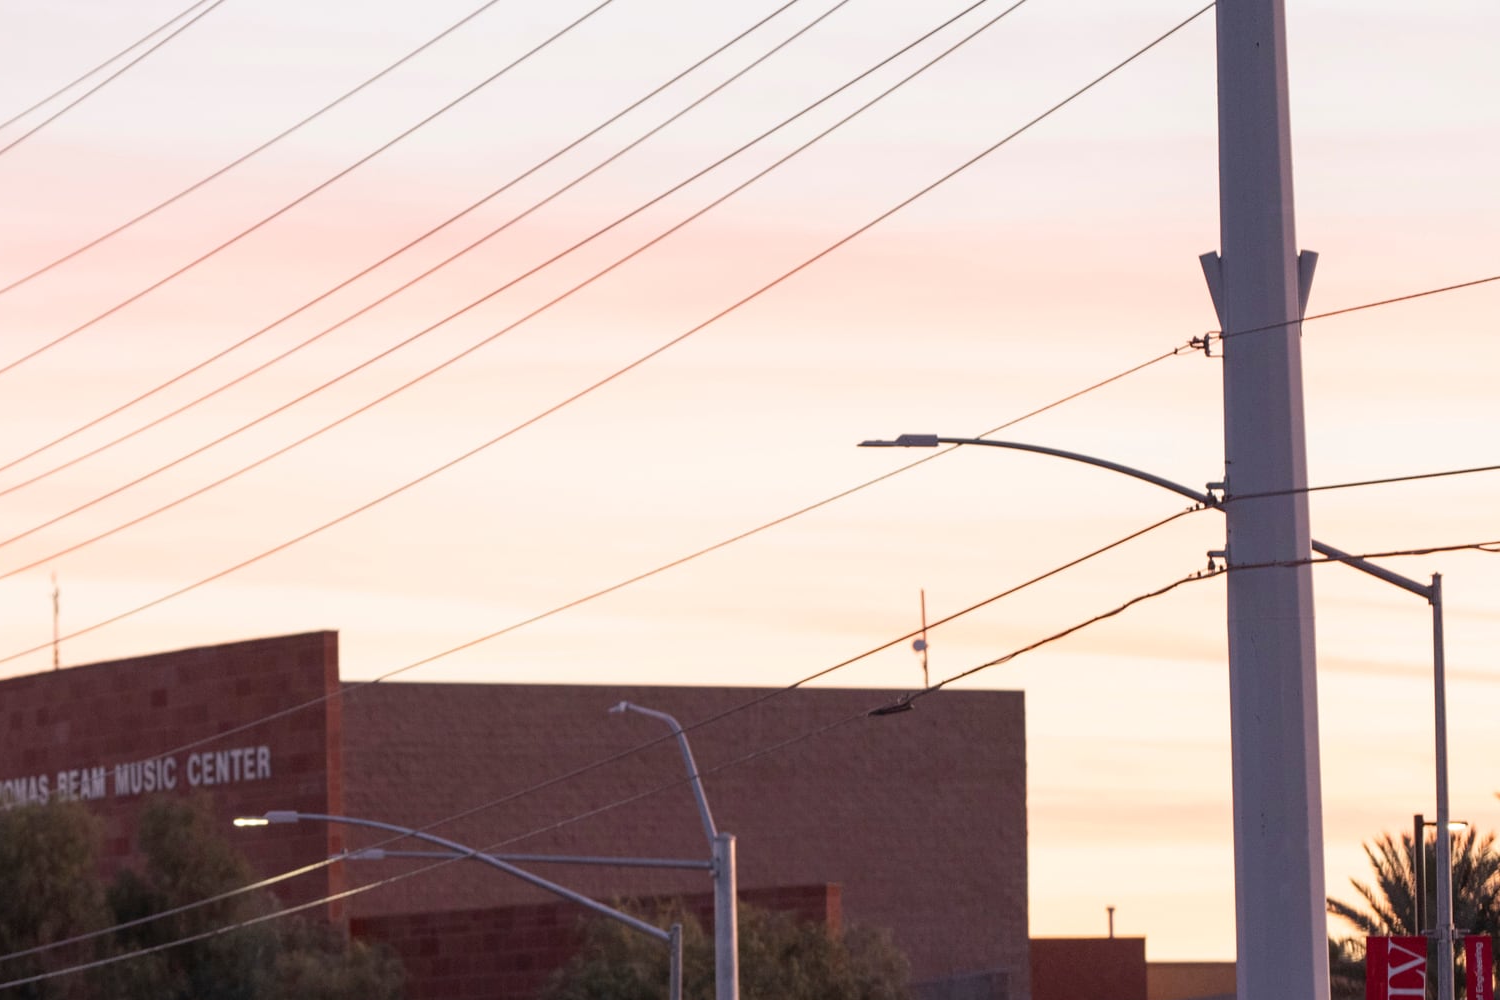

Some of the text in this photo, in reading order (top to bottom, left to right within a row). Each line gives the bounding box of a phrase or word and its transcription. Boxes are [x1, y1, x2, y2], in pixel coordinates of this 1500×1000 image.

[56, 765, 106, 802] BEAM
[114, 756, 177, 797] MUSIC
[187, 745, 271, 786] CENTER
[1475, 941, 1485, 993] Engineering
